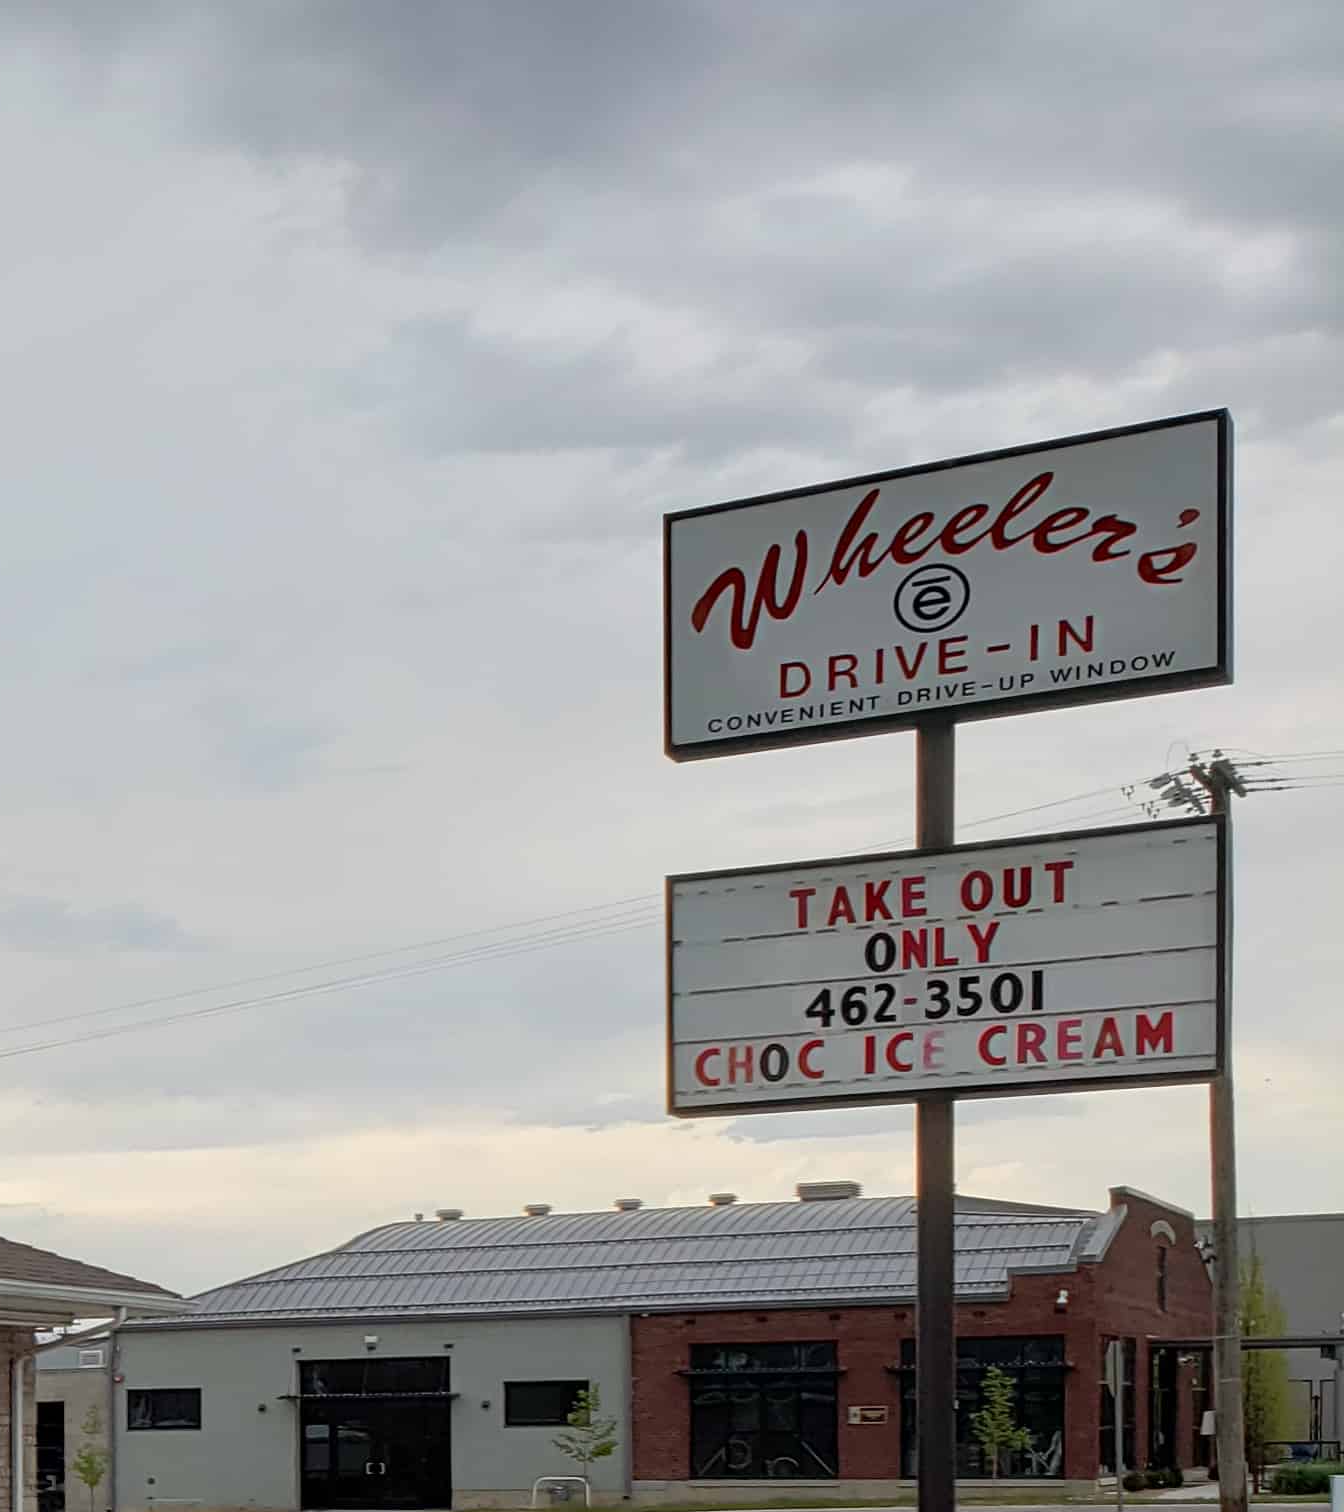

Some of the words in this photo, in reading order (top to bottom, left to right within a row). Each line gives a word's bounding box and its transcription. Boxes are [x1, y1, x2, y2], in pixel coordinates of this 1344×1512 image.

[691, 471, 1200, 650] Wheeler's
[707, 696, 880, 733] CONVENIENT
[896, 673, 1034, 706] DRIVE-UP
[1050, 651, 1177, 684] WINDOW
[779, 615, 1096, 699] DRIVE-IN
[789, 876, 926, 929] TAKE
[960, 860, 1075, 911] OUT
[864, 921, 1000, 973] ONLY
[805, 970, 1043, 1028] 462-3501
[695, 1039, 824, 1086] CHOC
[863, 1030, 944, 1075] ICE
[979, 1011, 1173, 1066] CREAM
